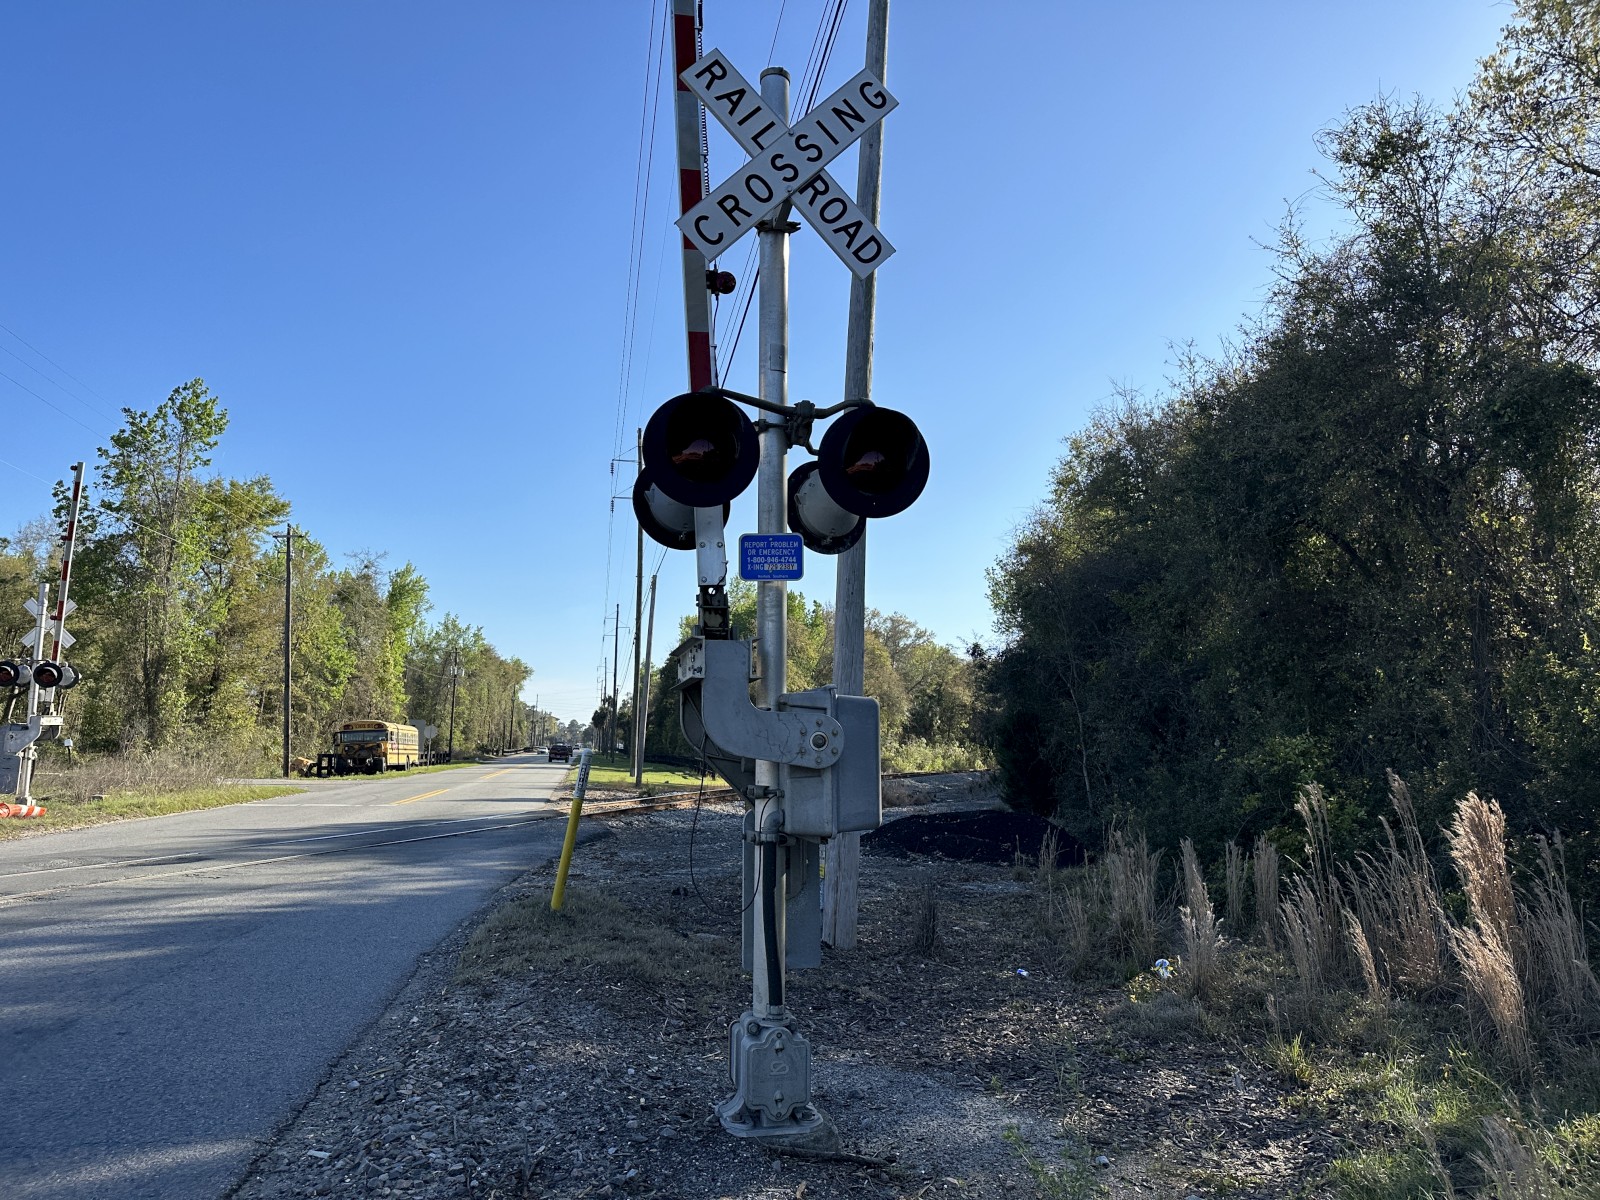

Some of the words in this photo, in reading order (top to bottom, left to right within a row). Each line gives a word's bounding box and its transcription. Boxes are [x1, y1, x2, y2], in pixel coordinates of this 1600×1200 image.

[694, 81, 887, 246] CROSSING
[695, 59, 776, 150] RAIL
[798, 173, 882, 264] ROAD
